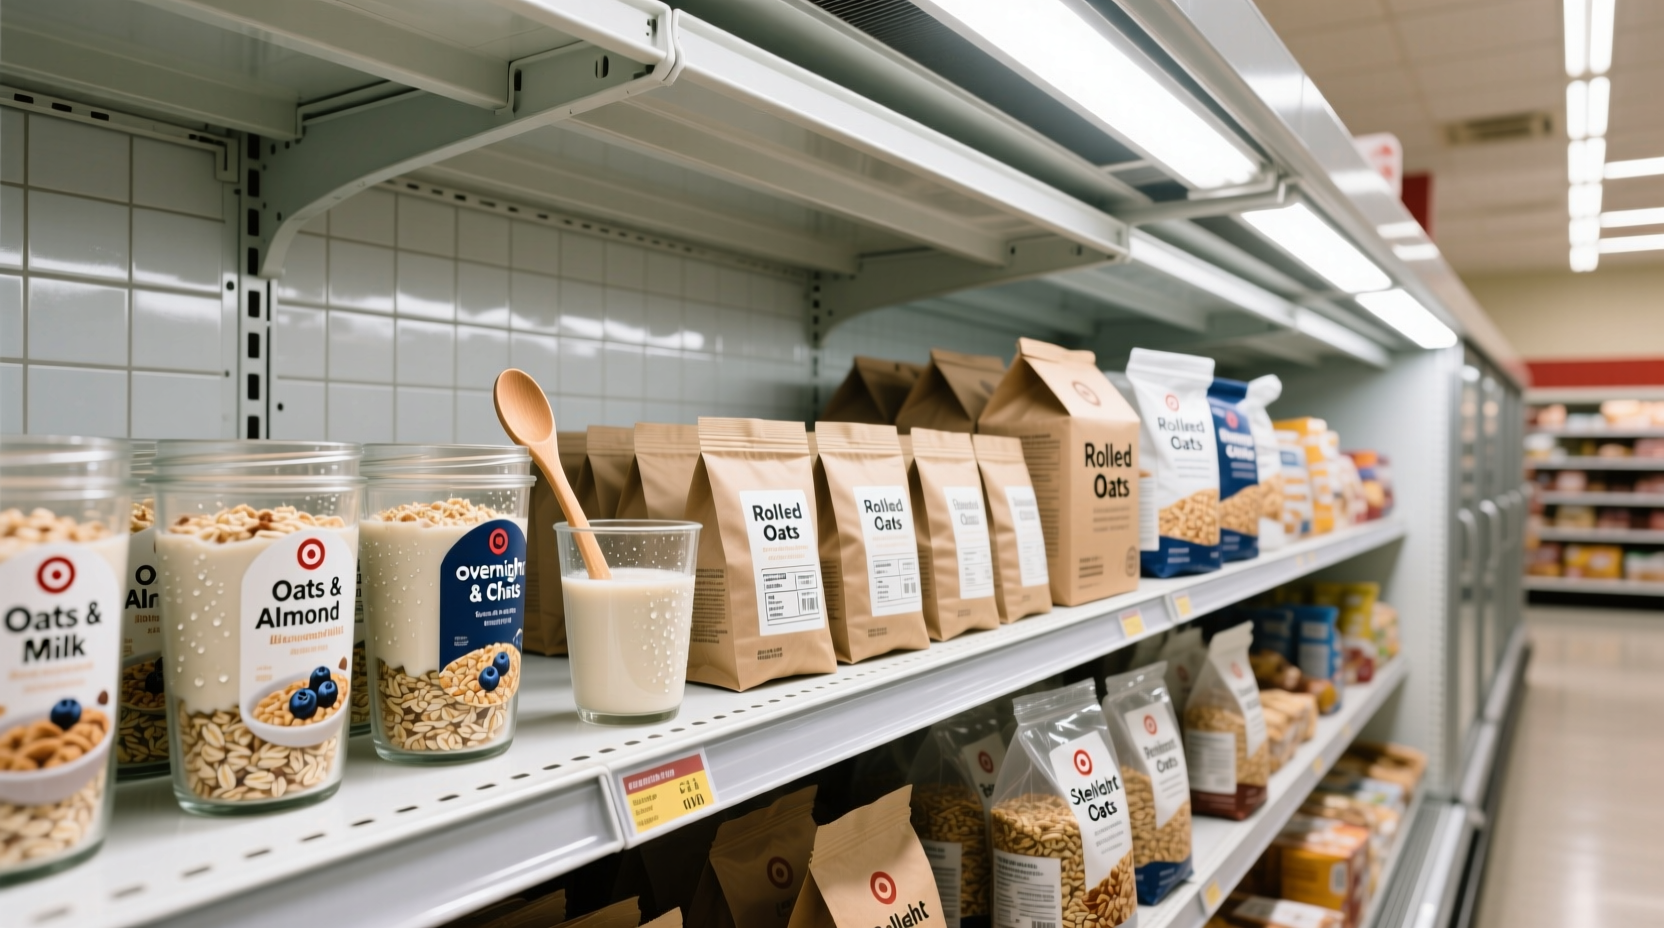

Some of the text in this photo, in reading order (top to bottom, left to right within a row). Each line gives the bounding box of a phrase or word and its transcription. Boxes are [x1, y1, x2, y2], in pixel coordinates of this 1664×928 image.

[1084, 442, 1132, 468] Rolled
[1093, 473, 1130, 498] Oats
[752, 502, 803, 522] Rolled
[763, 524, 801, 541] Oats
[272, 576, 342, 602] Oats &
[469, 583, 482, 603] &
[5, 601, 102, 634] Oats &
[254, 599, 340, 630] Almond
[22, 634, 86, 664] Milk
